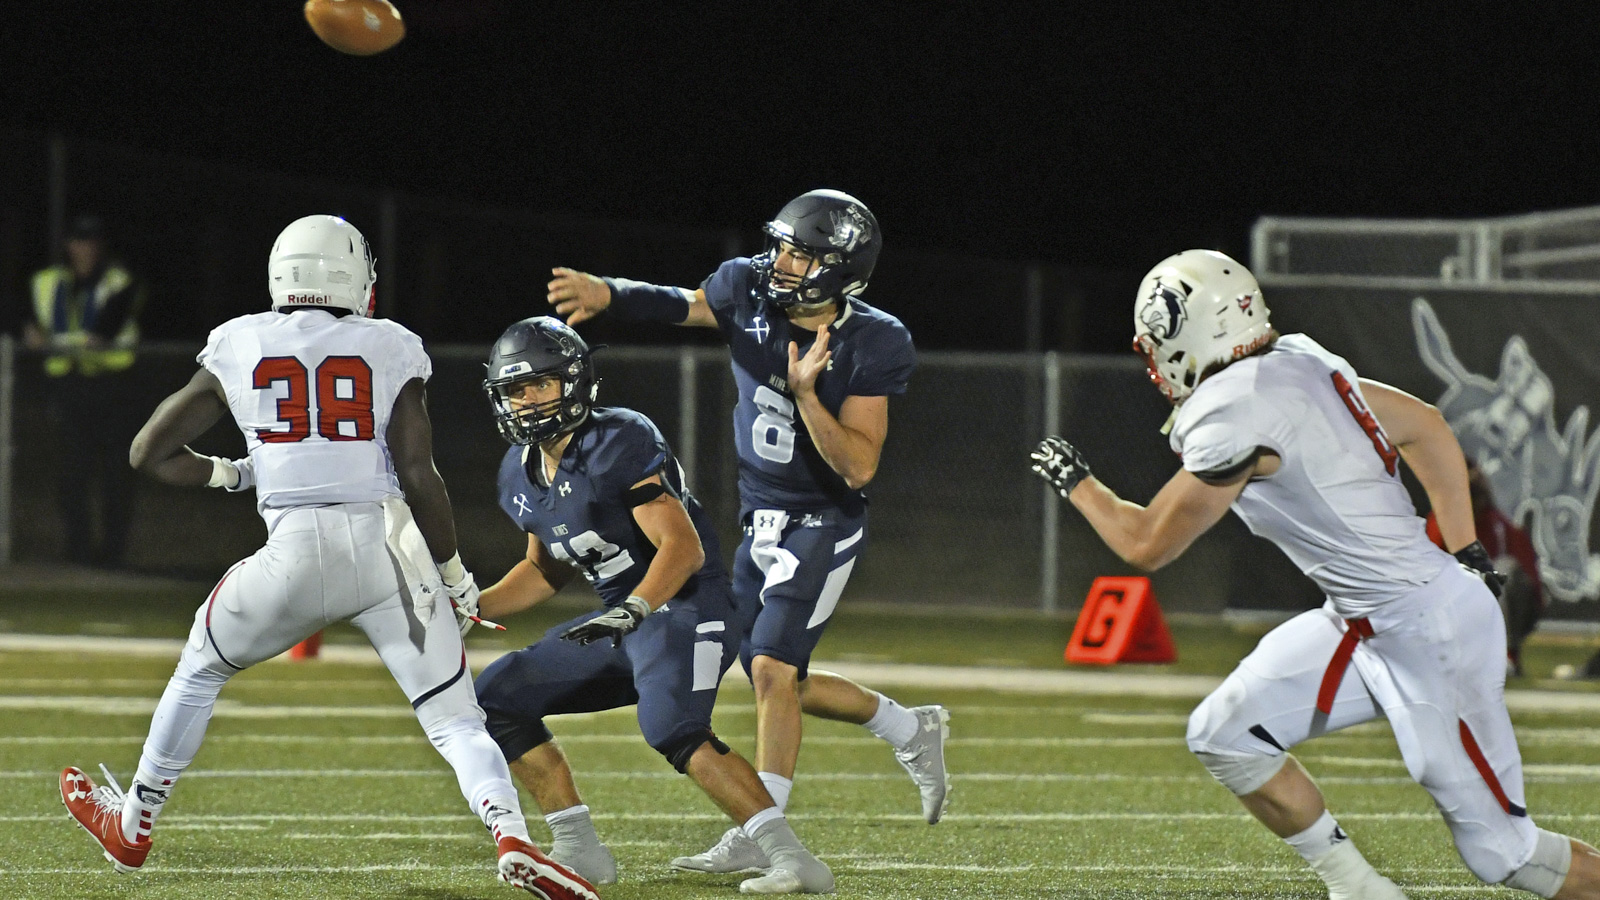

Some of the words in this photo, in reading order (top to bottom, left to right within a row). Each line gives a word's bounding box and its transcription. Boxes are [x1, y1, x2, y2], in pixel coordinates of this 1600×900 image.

[252, 355, 375, 443] 38
[752, 385, 796, 464] 8
[1081, 590, 1125, 648] G
